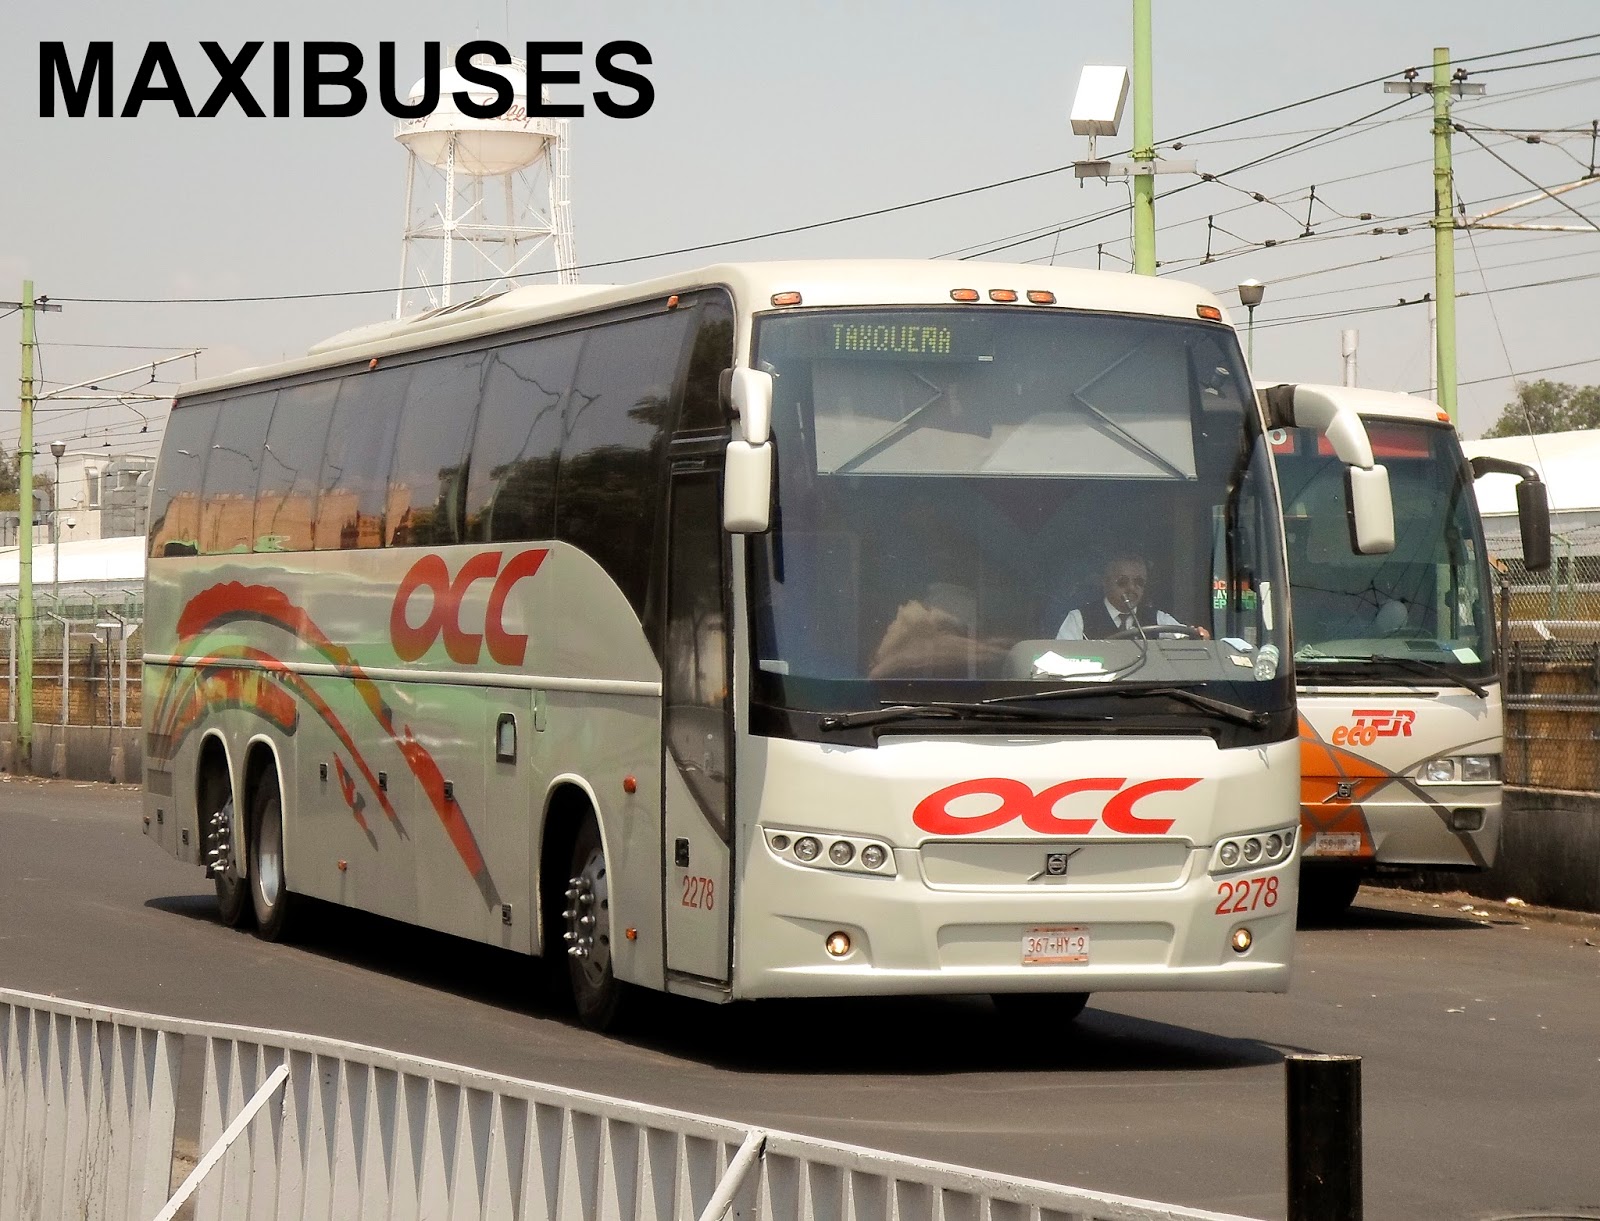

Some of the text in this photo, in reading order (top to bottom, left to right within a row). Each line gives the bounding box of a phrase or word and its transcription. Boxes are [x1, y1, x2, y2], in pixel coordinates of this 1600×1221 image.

[390, 549, 548, 666] OCC
[1331, 725, 1378, 747] eco
[912, 777, 1204, 835] OCC
[681, 875, 714, 911] 2278
[1215, 876, 1279, 915] 2278
[1027, 937, 1085, 954] 367-HY-9
